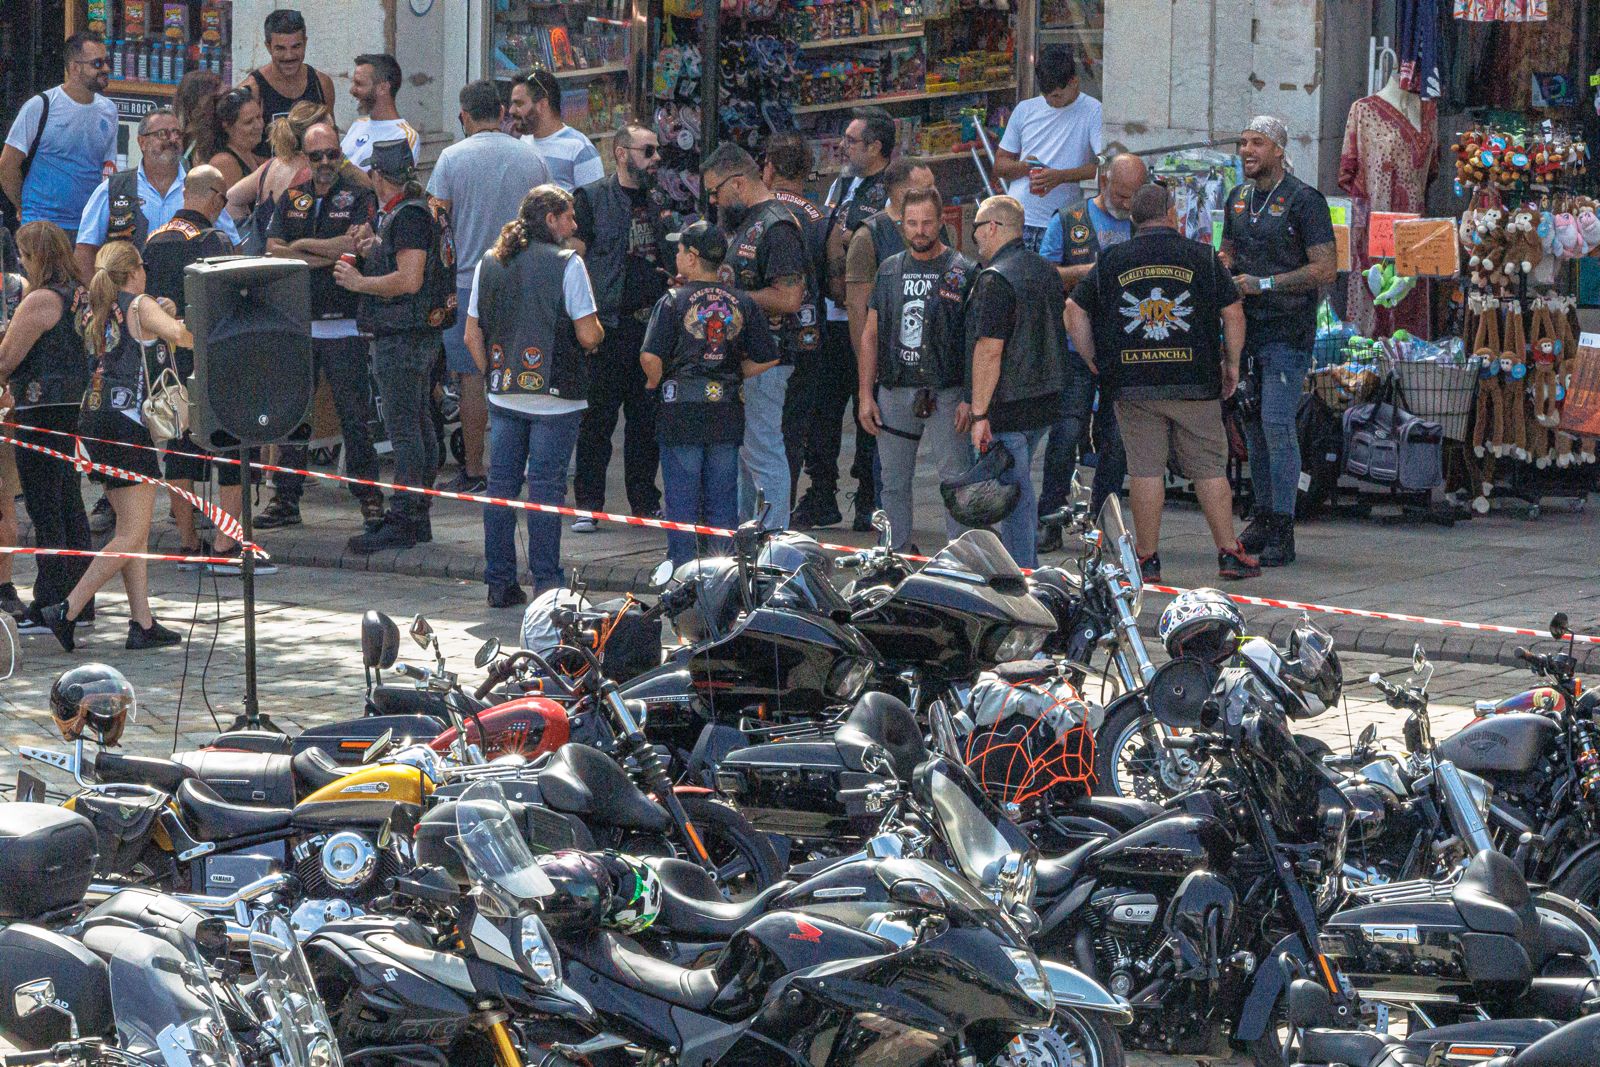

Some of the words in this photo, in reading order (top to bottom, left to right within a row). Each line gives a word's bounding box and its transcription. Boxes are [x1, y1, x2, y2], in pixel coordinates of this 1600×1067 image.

[114, 52, 122, 77] PRIME
[131, 103, 152, 114] ROCK
[776, 193, 806, 206] DAVIDSON
[804, 204, 820, 219] CLUB
[1174, 269, 1191, 281] CLUB
[1139, 299, 1176, 321] HDC
[1125, 352, 1138, 361] LA
[1142, 351, 1187, 360] MANCHA
[789, 933, 820, 943] HONDA
